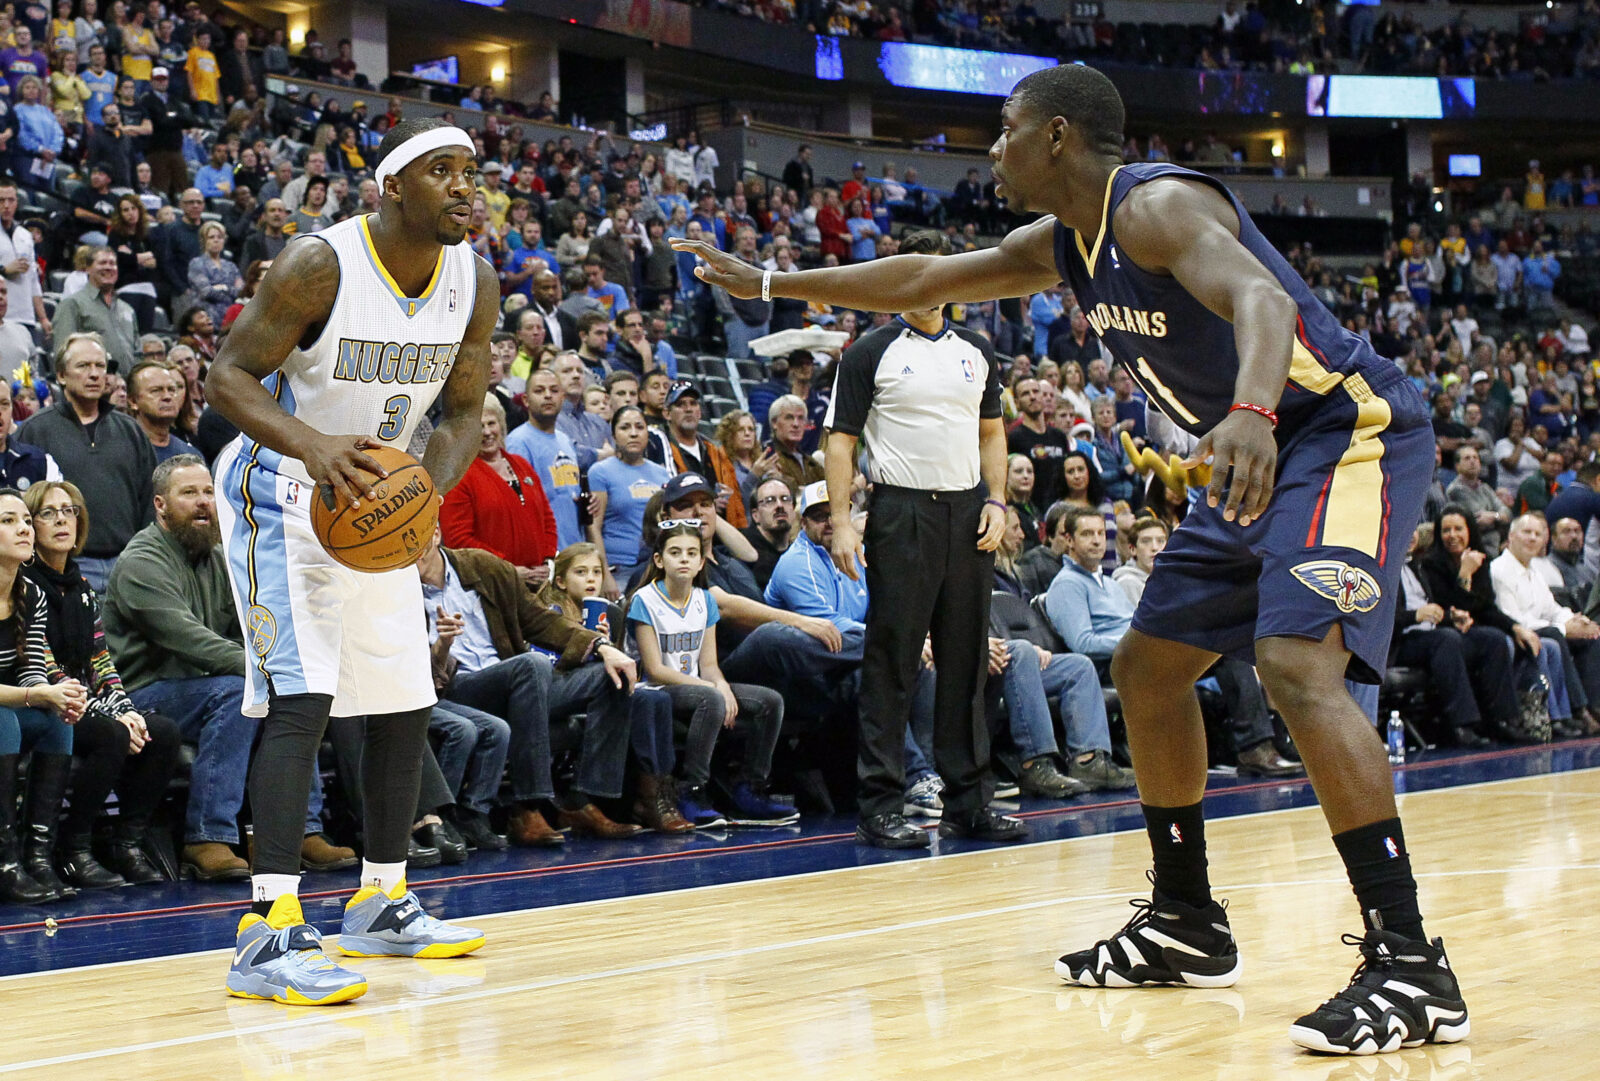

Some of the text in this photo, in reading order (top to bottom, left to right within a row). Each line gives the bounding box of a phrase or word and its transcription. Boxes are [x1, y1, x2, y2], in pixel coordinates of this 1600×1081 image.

[333, 338, 461, 384] NUGGETS
[377, 394, 412, 442] 3
[352, 474, 429, 539] SPALDING
[680, 653, 693, 675] 3
